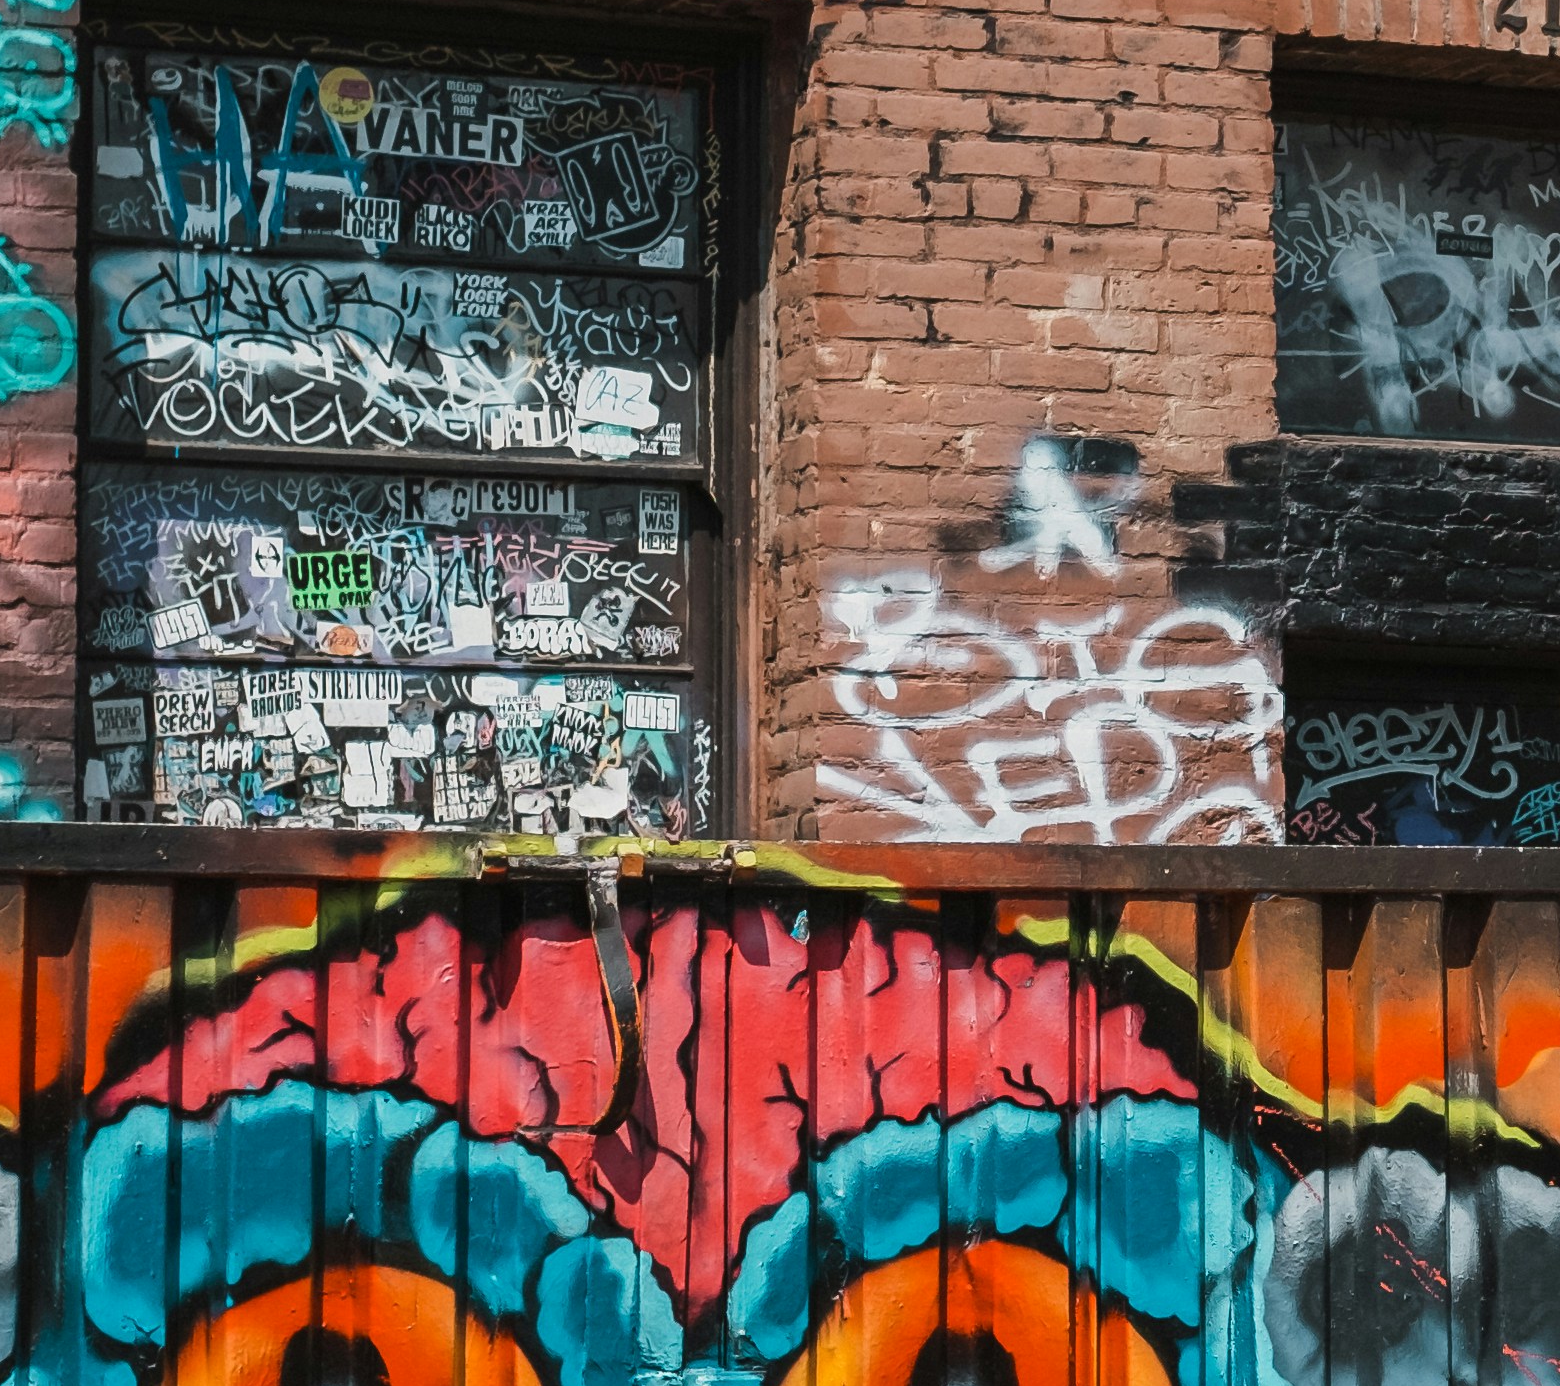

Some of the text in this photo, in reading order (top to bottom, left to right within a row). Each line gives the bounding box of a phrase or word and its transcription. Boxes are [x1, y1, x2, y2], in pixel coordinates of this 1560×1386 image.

[359, 103, 520, 164] VANER
[345, 196, 399, 219] KUDI
[342, 217, 398, 241] LOGEK
[534, 217, 571, 233] ART
[416, 224, 470, 251] RIKO
[455, 273, 508, 291] YORK
[453, 289, 509, 306] LOGEK
[456, 302, 503, 319] FOUL
[642, 492, 678, 513] FOSH
[645, 513, 674, 531] WAS
[641, 531, 678, 553] HERE
[289, 552, 370, 591] URGE
[249, 671, 296, 696] FORSE
[155, 691, 210, 717] DREW
[158, 710, 212, 736] SERCH
